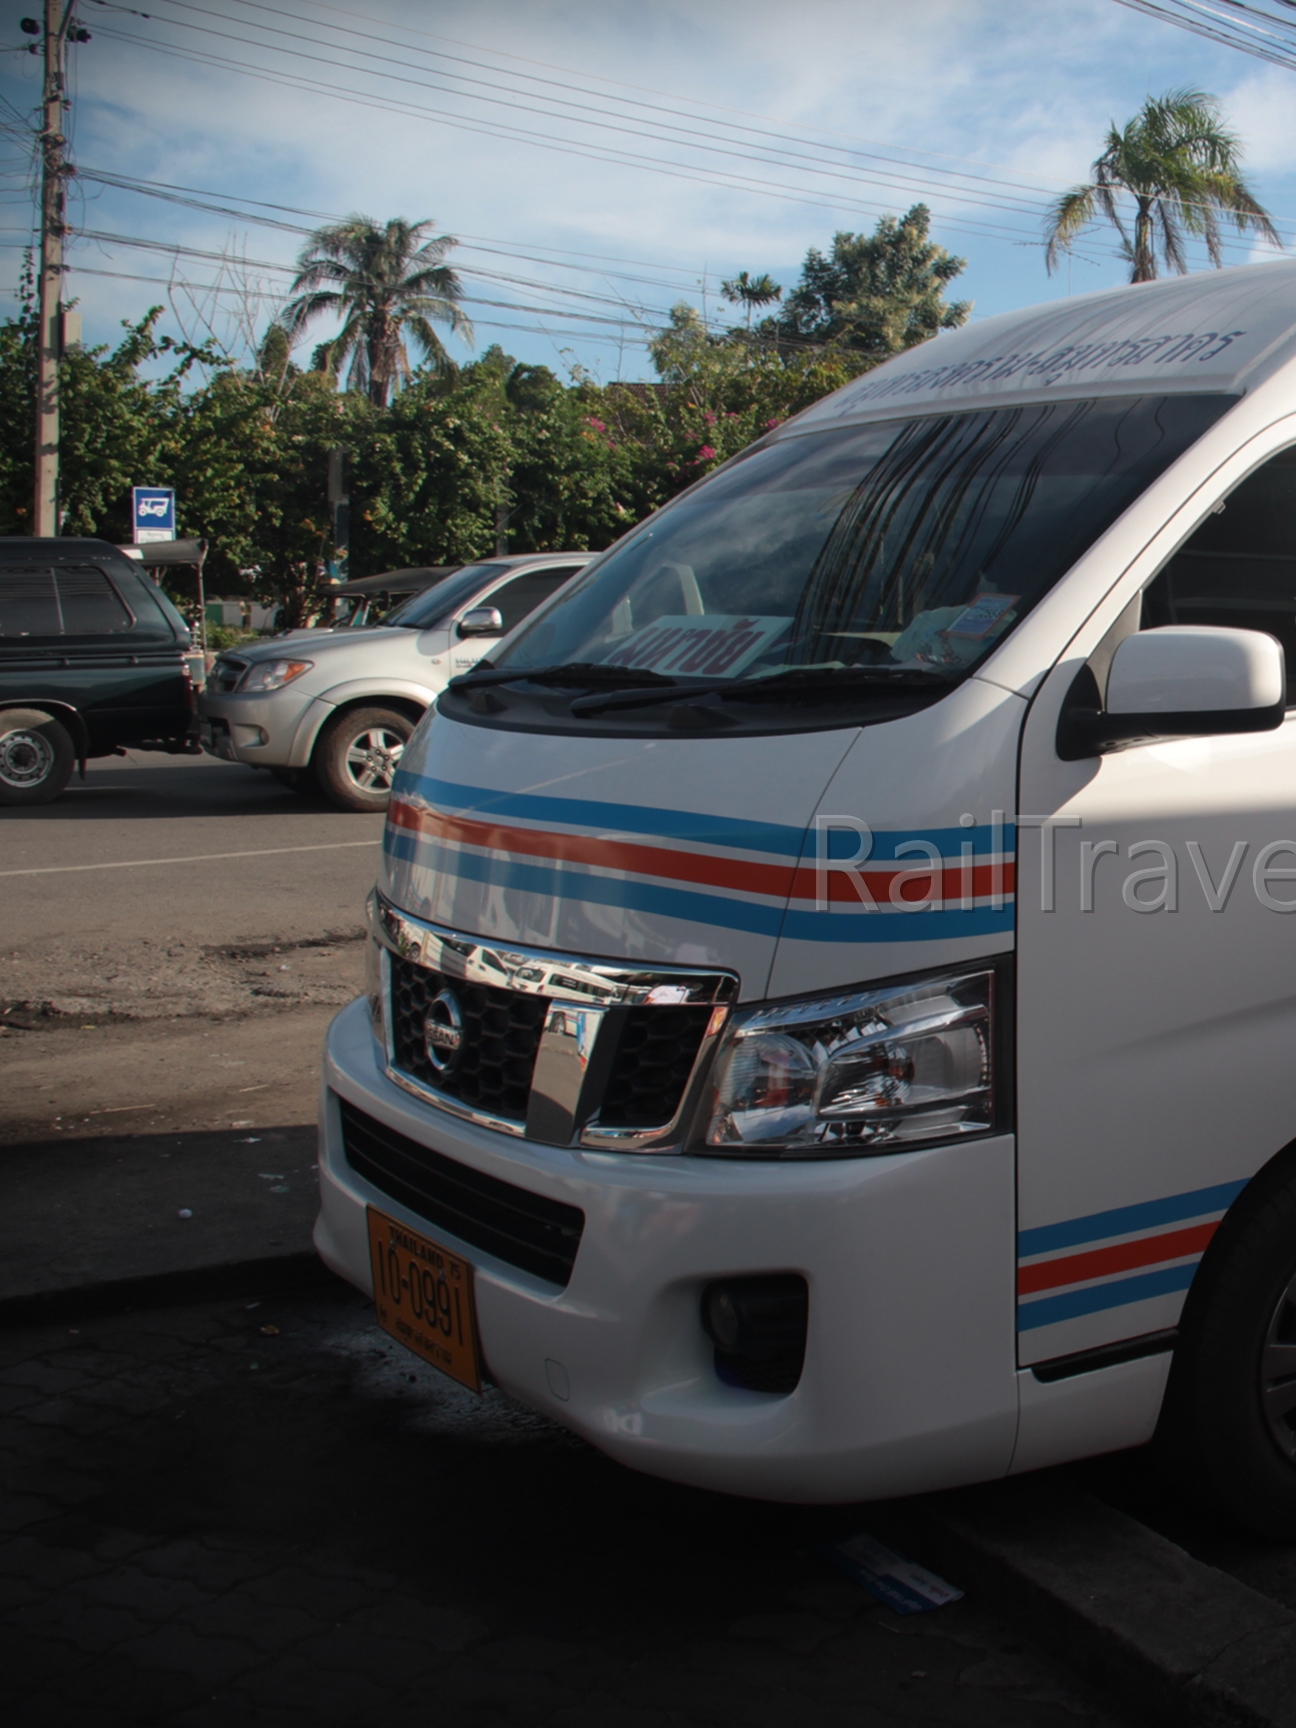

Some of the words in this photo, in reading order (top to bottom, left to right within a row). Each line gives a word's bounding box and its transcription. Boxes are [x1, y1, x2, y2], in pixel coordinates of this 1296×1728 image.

[606, 618, 767, 675] มหาชัย
[424, 1020, 460, 1048] SSAN
[389, 1225, 444, 1269] THAILAND
[378, 1239, 463, 1346] 10-0991
